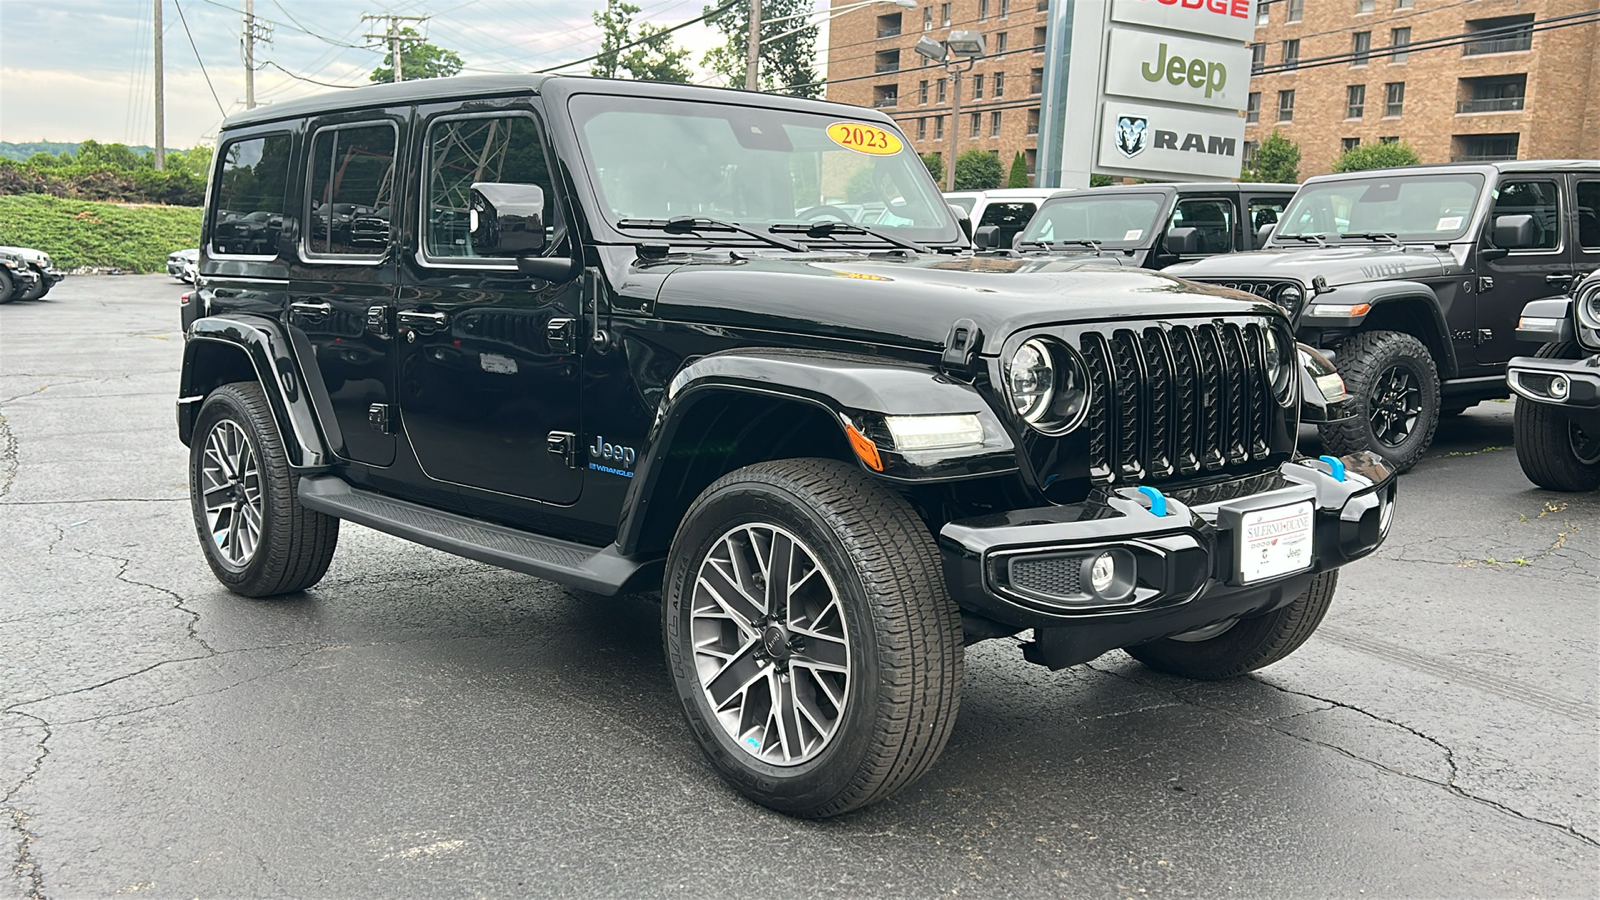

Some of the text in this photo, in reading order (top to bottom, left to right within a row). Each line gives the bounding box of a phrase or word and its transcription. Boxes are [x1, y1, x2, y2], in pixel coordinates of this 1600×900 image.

[1141, 0, 1249, 19] DGE
[1141, 43, 1227, 98] Jeep
[841, 126, 888, 149] 2023
[1153, 129, 1236, 157] RAM
[589, 435, 636, 469] Jeep
